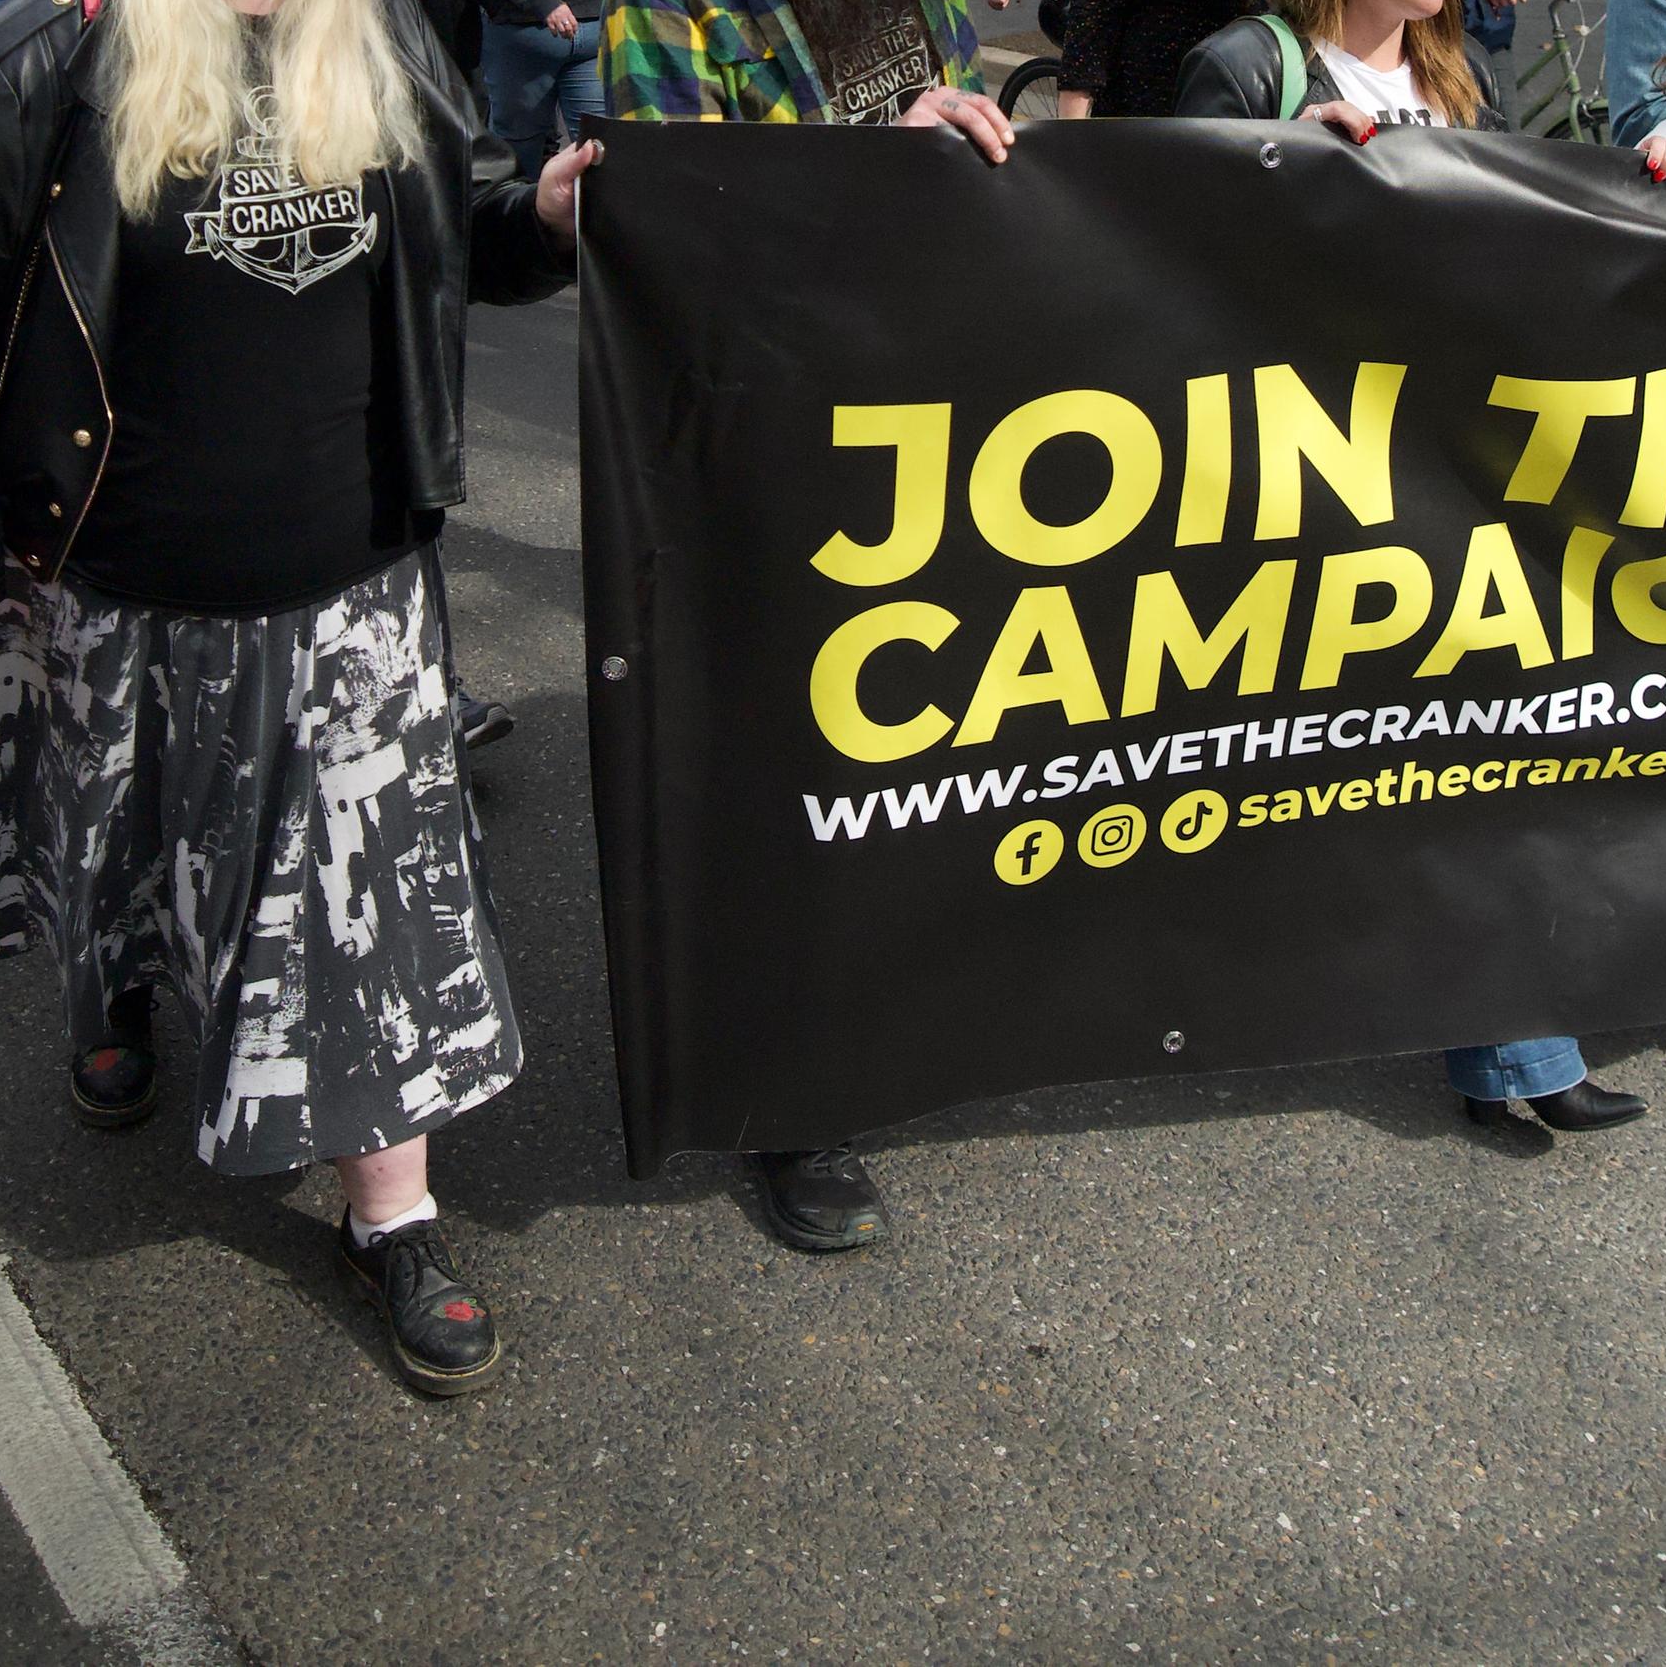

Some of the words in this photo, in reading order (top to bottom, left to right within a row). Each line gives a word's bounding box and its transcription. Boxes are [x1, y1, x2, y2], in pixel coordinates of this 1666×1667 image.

[841, 40, 883, 78] SAVE
[883, 27, 917, 56] THE
[845, 55, 926, 112] CRANKER
[232, 190, 357, 234] CRANKER
[808, 361, 1408, 587] JOIN
